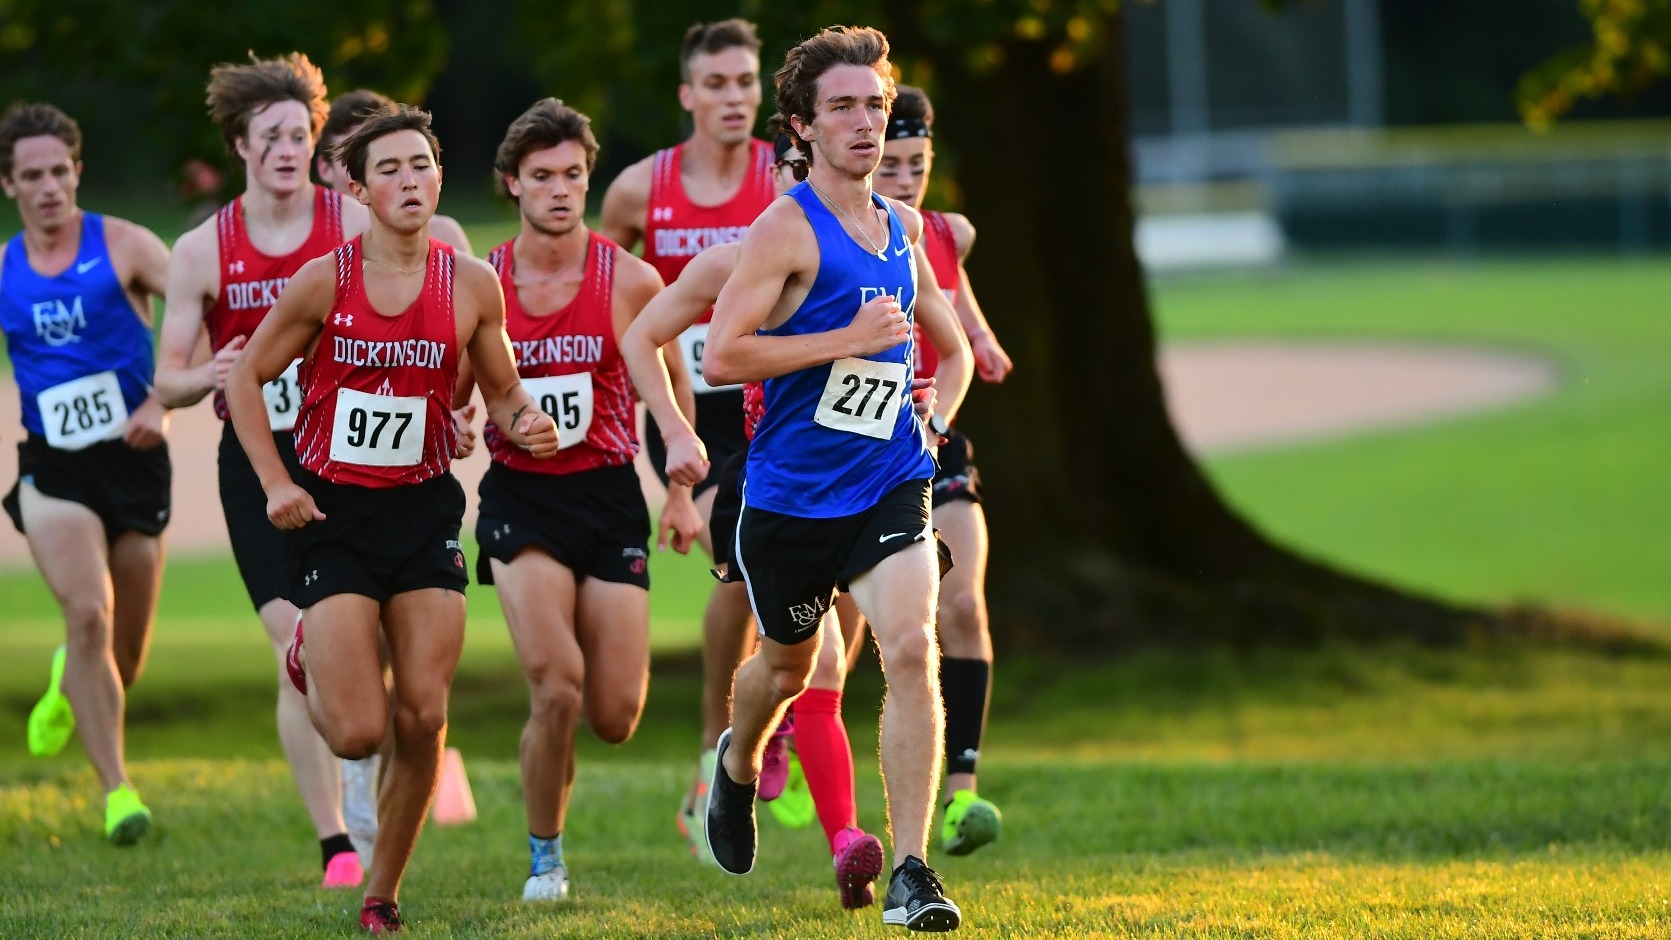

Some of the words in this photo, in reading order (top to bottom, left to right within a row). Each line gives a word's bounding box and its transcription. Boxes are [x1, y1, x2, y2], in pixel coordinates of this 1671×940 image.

[334, 335, 446, 369] DICKINSON
[54, 389, 114, 437] 285
[831, 373, 898, 420] 277
[347, 407, 413, 450] 977
